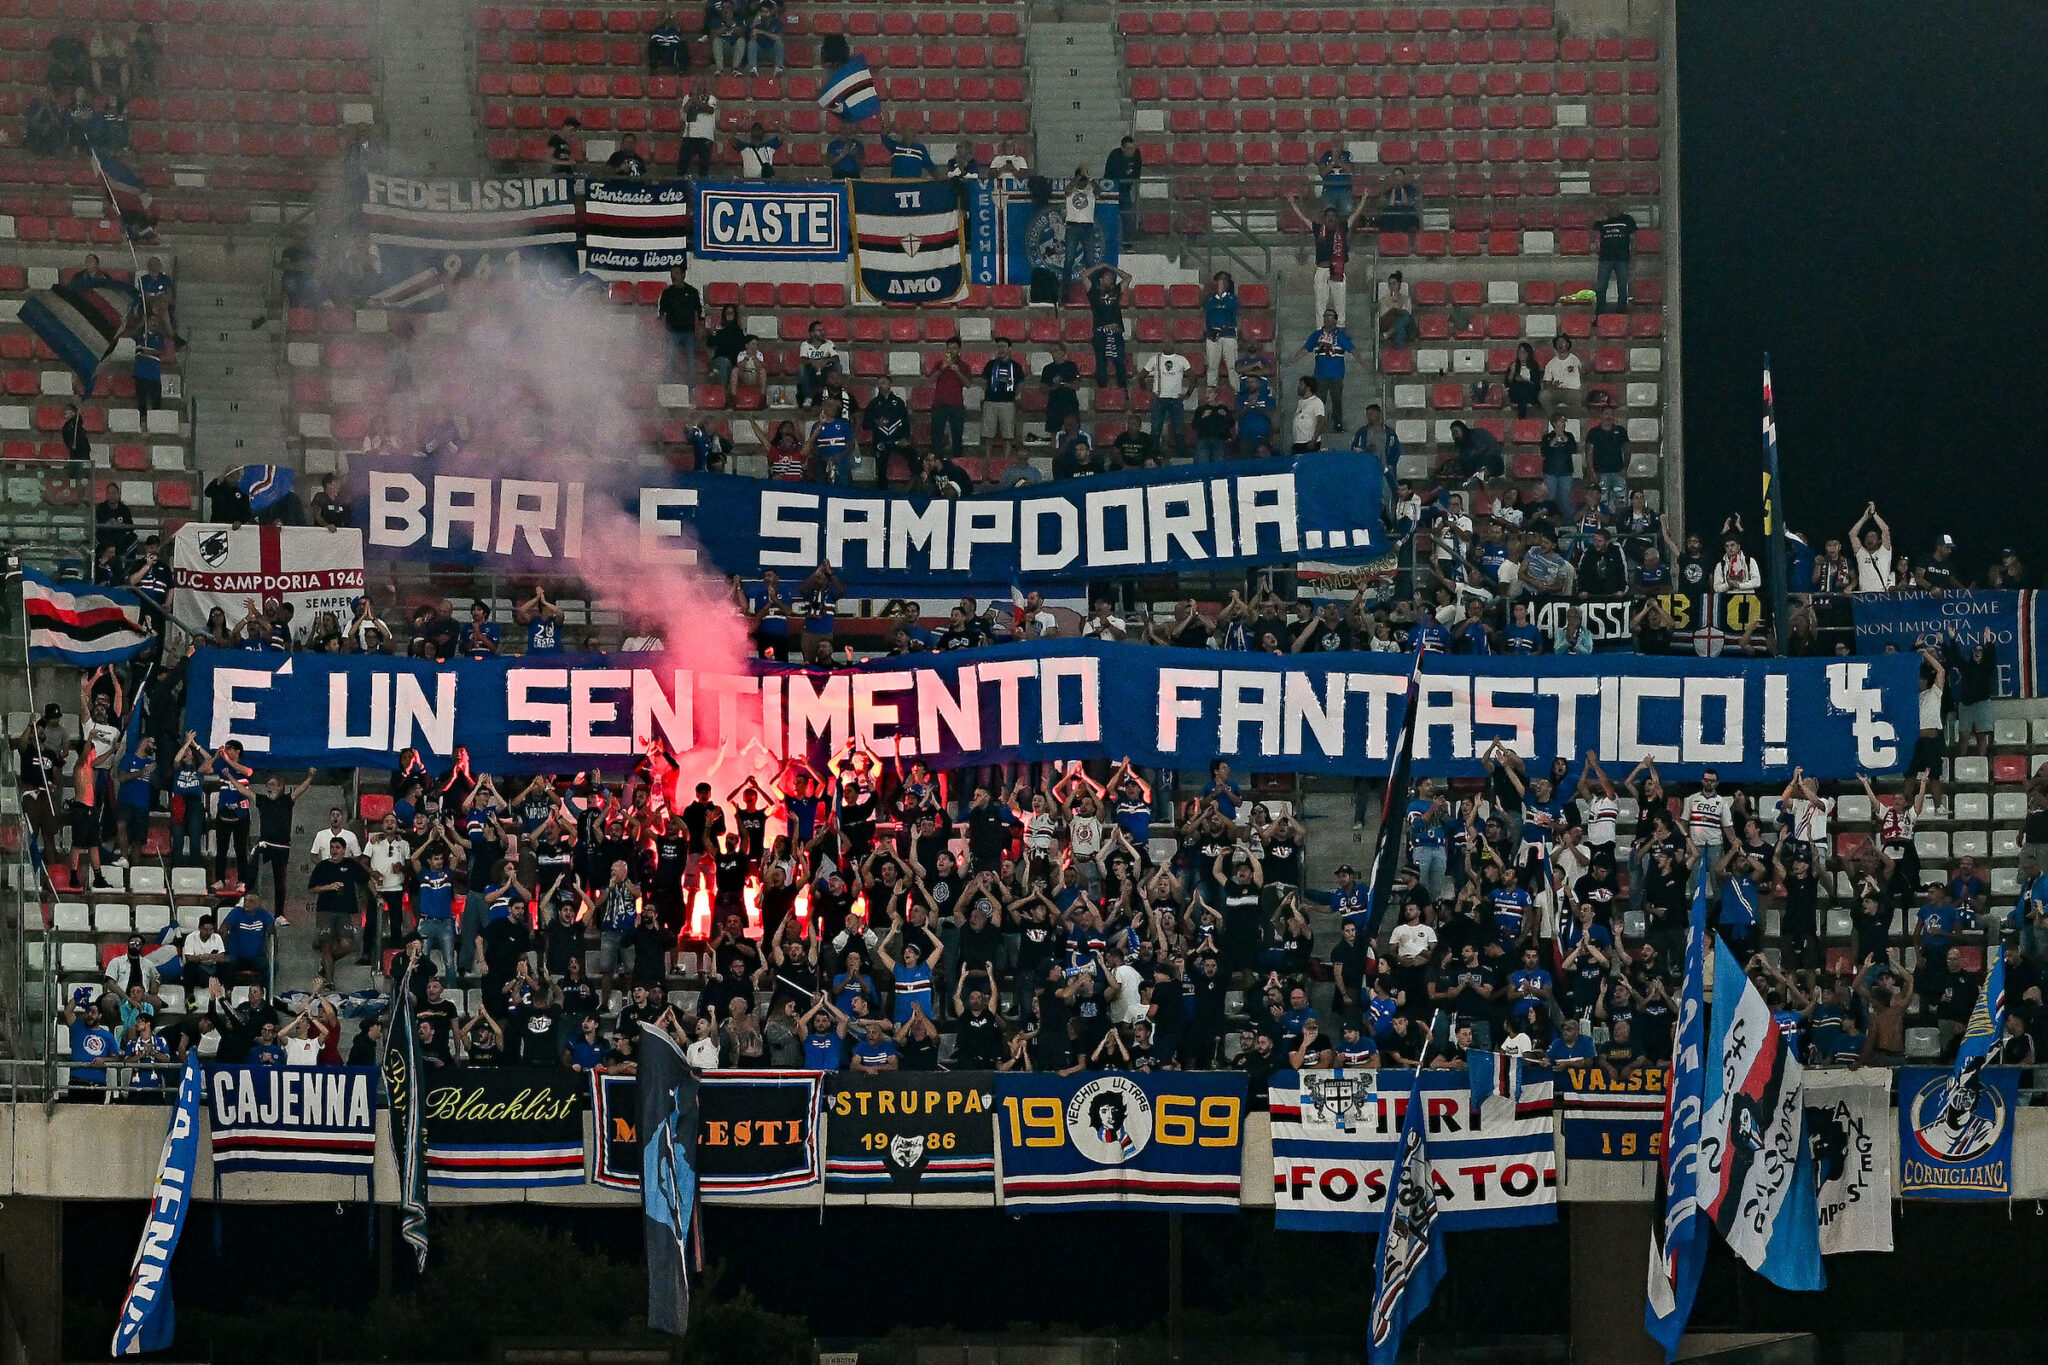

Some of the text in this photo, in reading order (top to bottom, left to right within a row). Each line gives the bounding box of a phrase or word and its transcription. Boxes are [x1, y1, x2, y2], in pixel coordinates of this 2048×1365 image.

[589, 182, 684, 203] Fantasie che
[895, 192, 921, 209] TI
[711, 200, 830, 244] CASTE
[590, 251, 684, 268] volano libere
[888, 276, 942, 295] AMO
[369, 470, 585, 560] BARI
[639, 487, 699, 566] E
[176, 570, 364, 591] U.C. SAMPDORIA 1946
[305, 596, 353, 609] SEMPER
[1941, 600, 2000, 616] COME
[1855, 618, 1972, 636] NON IMPORTA
[1924, 630, 2013, 649] QANDO
[327, 671, 458, 755] UN
[506, 656, 1101, 760] SENTIMENTO
[1156, 667, 1789, 766] FANTASTICO!
[1696, 803, 1718, 813] ERG
[213, 1069, 370, 1127] CAJENNA
[425, 1087, 577, 1121] Blacklist
[836, 1089, 982, 1117] STRUPPA
[1068, 1078, 1149, 1126] VECCHIO ULTRAS
[612, 1117, 803, 1146] MESTI
[1833, 1099, 1873, 1203] ANGELS
[1291, 1163, 1539, 1204] FOSATO
[1904, 1160, 2003, 1186] CORNIGLIANO
